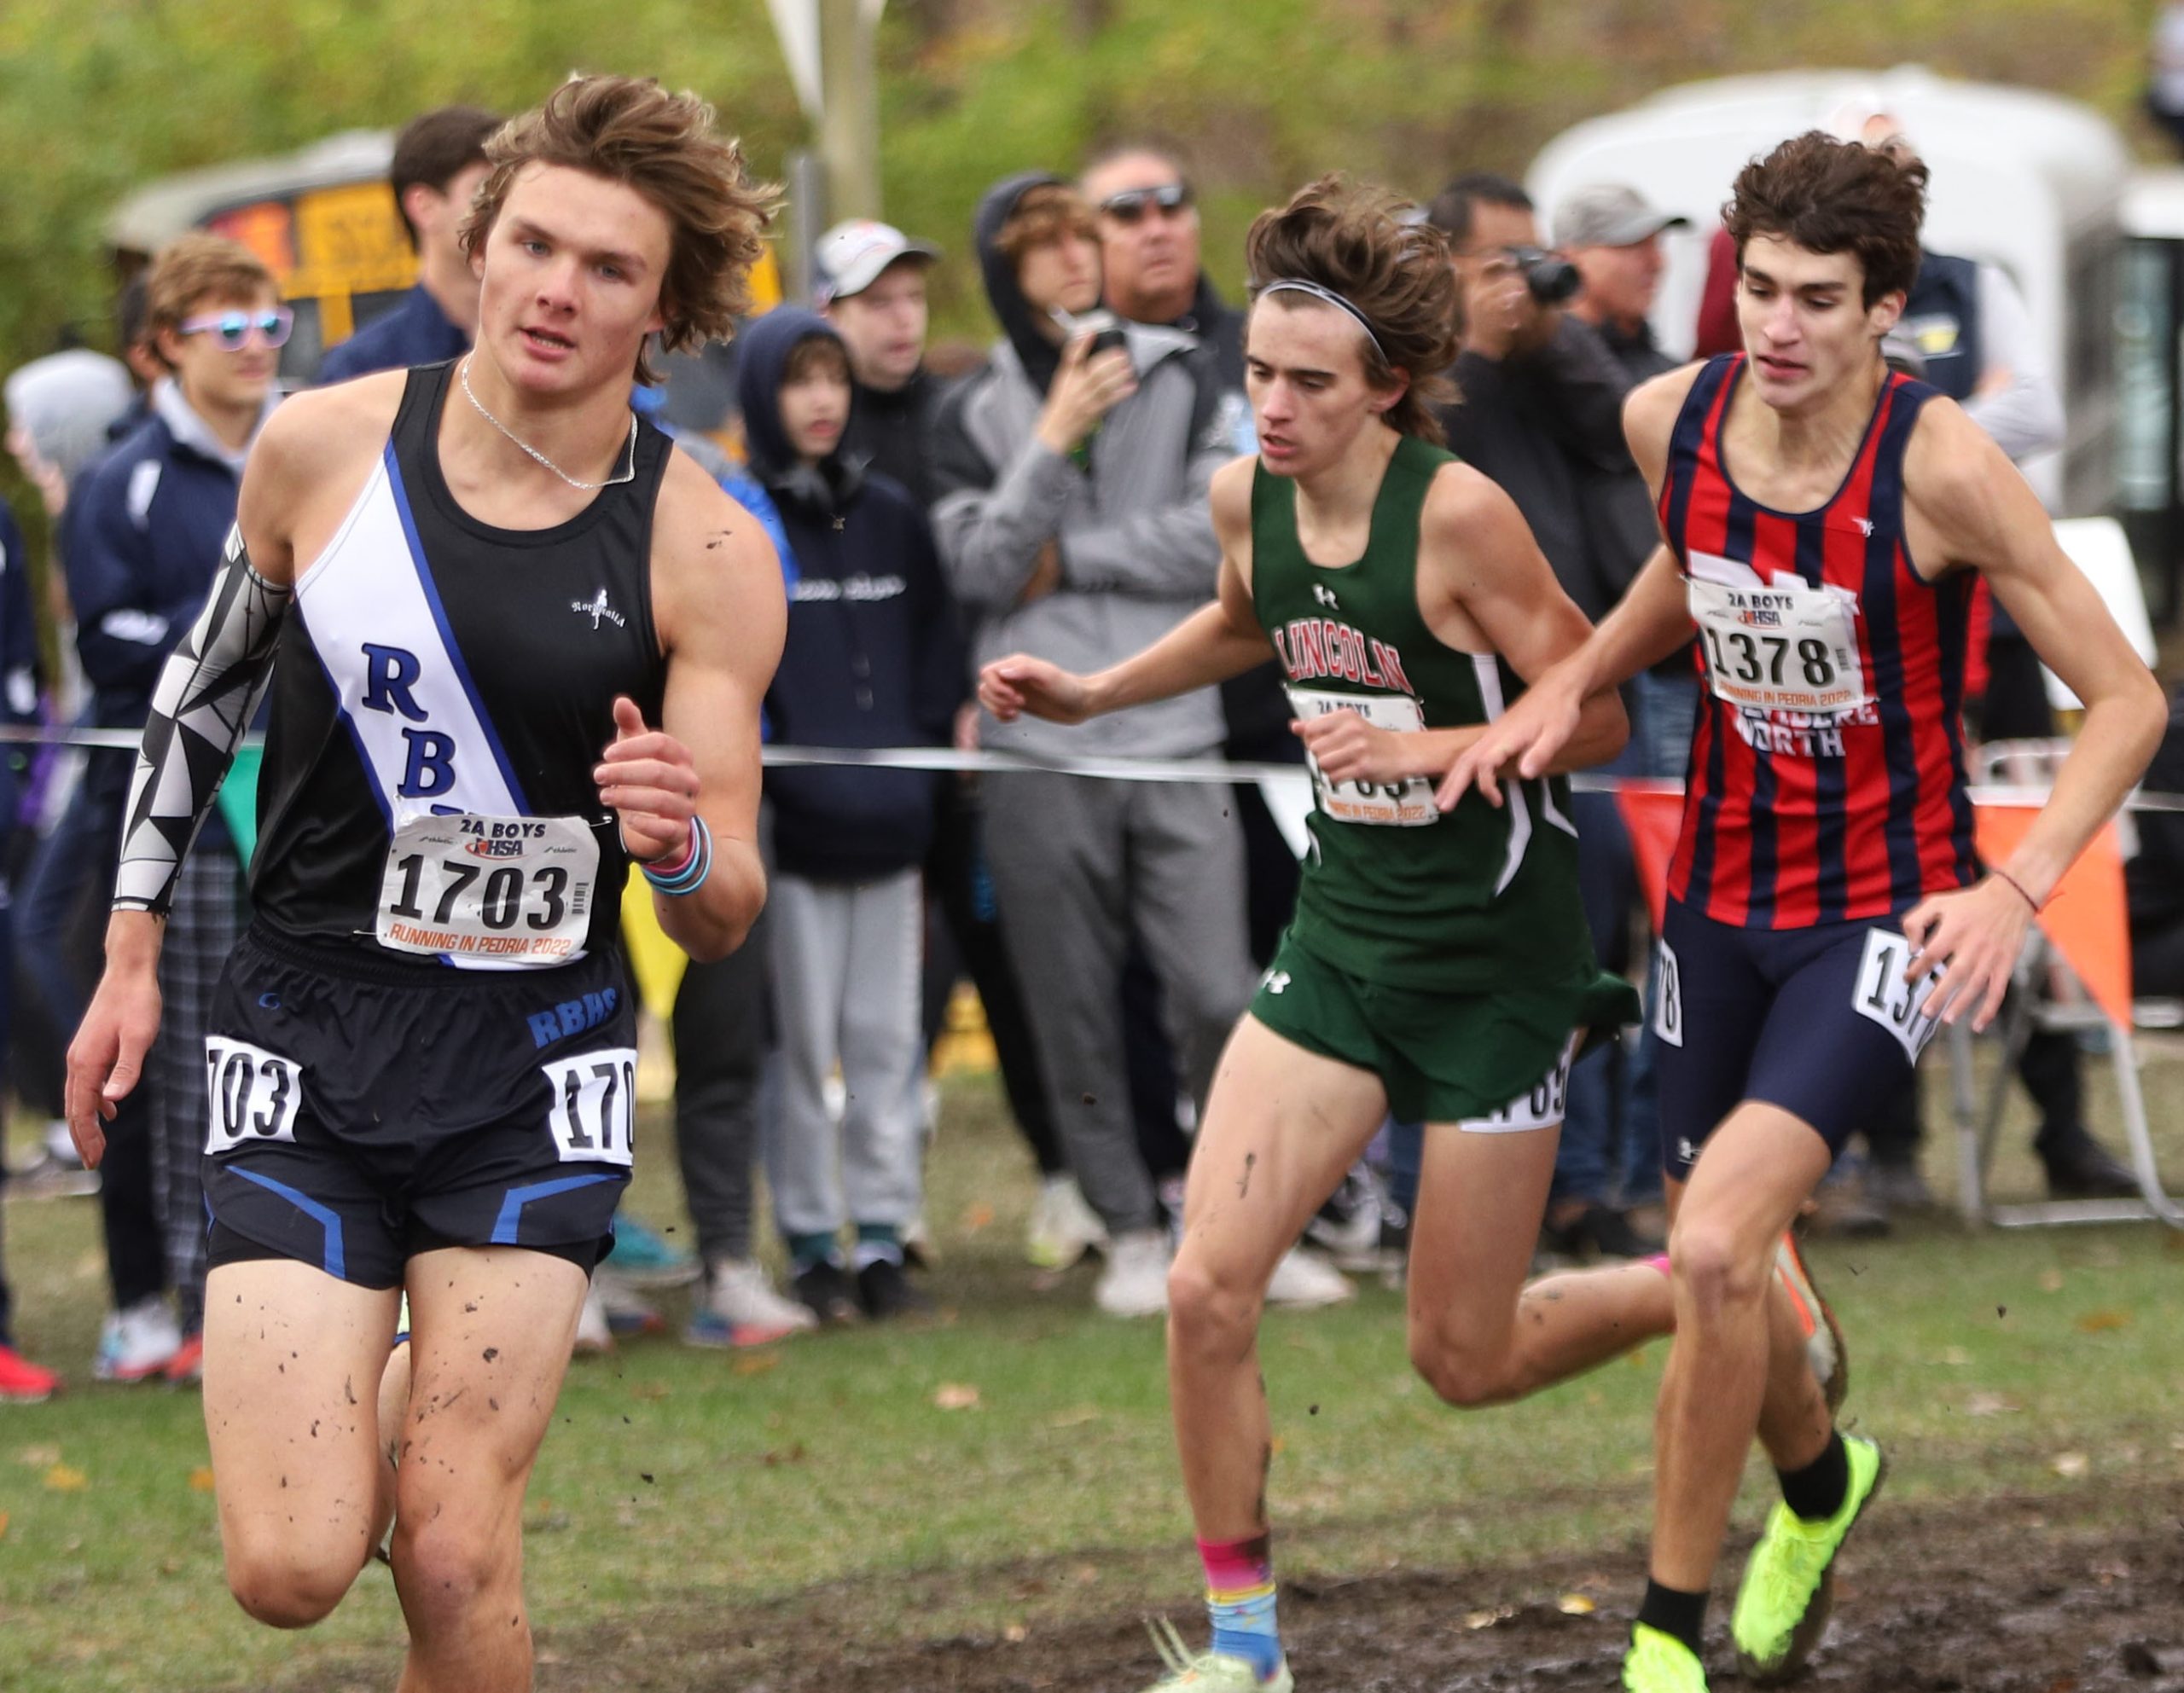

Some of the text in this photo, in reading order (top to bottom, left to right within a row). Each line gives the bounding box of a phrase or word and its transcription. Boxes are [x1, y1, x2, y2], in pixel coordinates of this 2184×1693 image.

[1728, 593, 1793, 610] 2A BOYS
[1274, 617, 1414, 696] LINCOLN
[1707, 628, 1835, 687] 1378
[1763, 691, 1775, 704] IN
[1777, 692, 1816, 706] PEORIA
[1820, 689, 1851, 706] 2022
[460, 819, 546, 838] 2A BOYS
[390, 854, 568, 931] 1703
[389, 923, 572, 956] RUNNING IN PEORIA 2022
